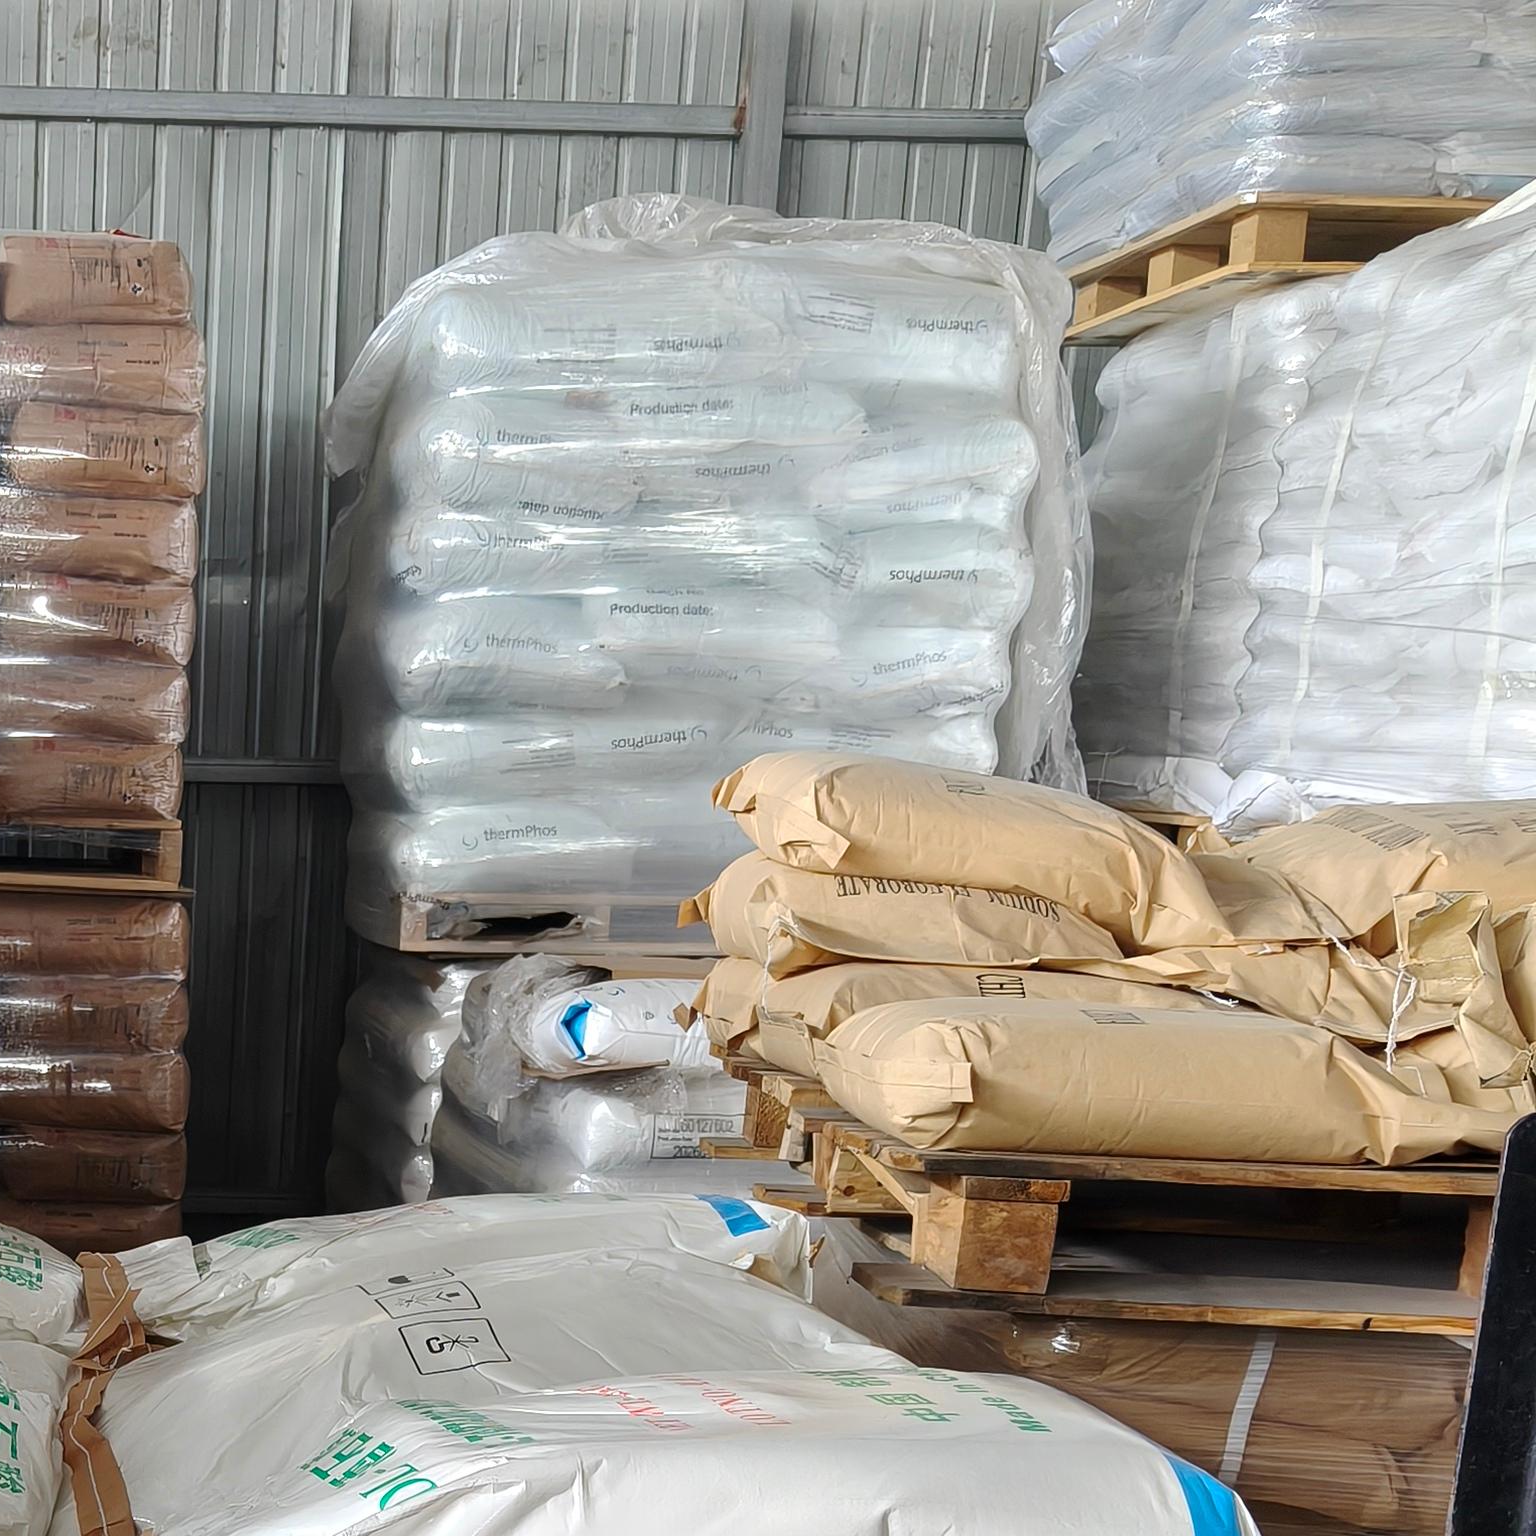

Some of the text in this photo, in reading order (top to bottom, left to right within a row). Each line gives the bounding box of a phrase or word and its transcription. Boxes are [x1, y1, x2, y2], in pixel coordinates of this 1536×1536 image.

[609, 602, 715, 618] Production date:
[484, 633, 559, 654] thermPhos
[610, 729, 687, 750] thermPhos
[482, 824, 558, 842] thermPhos
